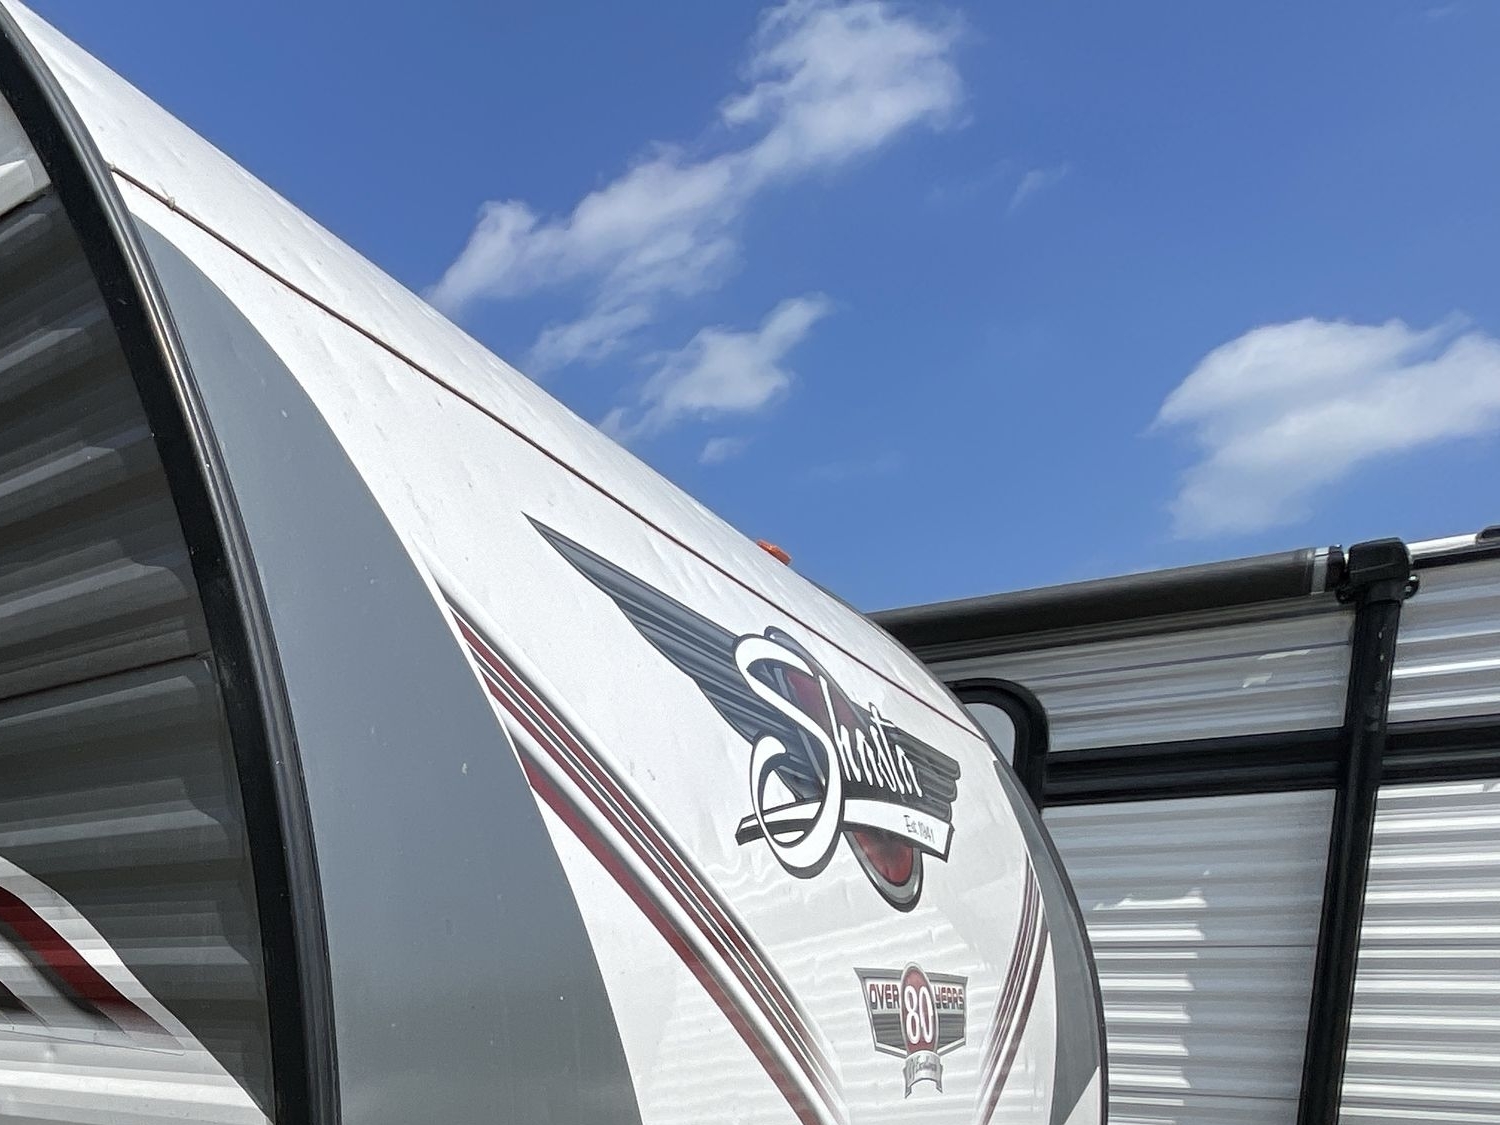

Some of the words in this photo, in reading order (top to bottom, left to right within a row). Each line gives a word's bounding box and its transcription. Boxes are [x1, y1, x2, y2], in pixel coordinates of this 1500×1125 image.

[868, 983, 900, 1010] OVER
[903, 984, 934, 1045] 80
[934, 986, 965, 1010] YEARS
